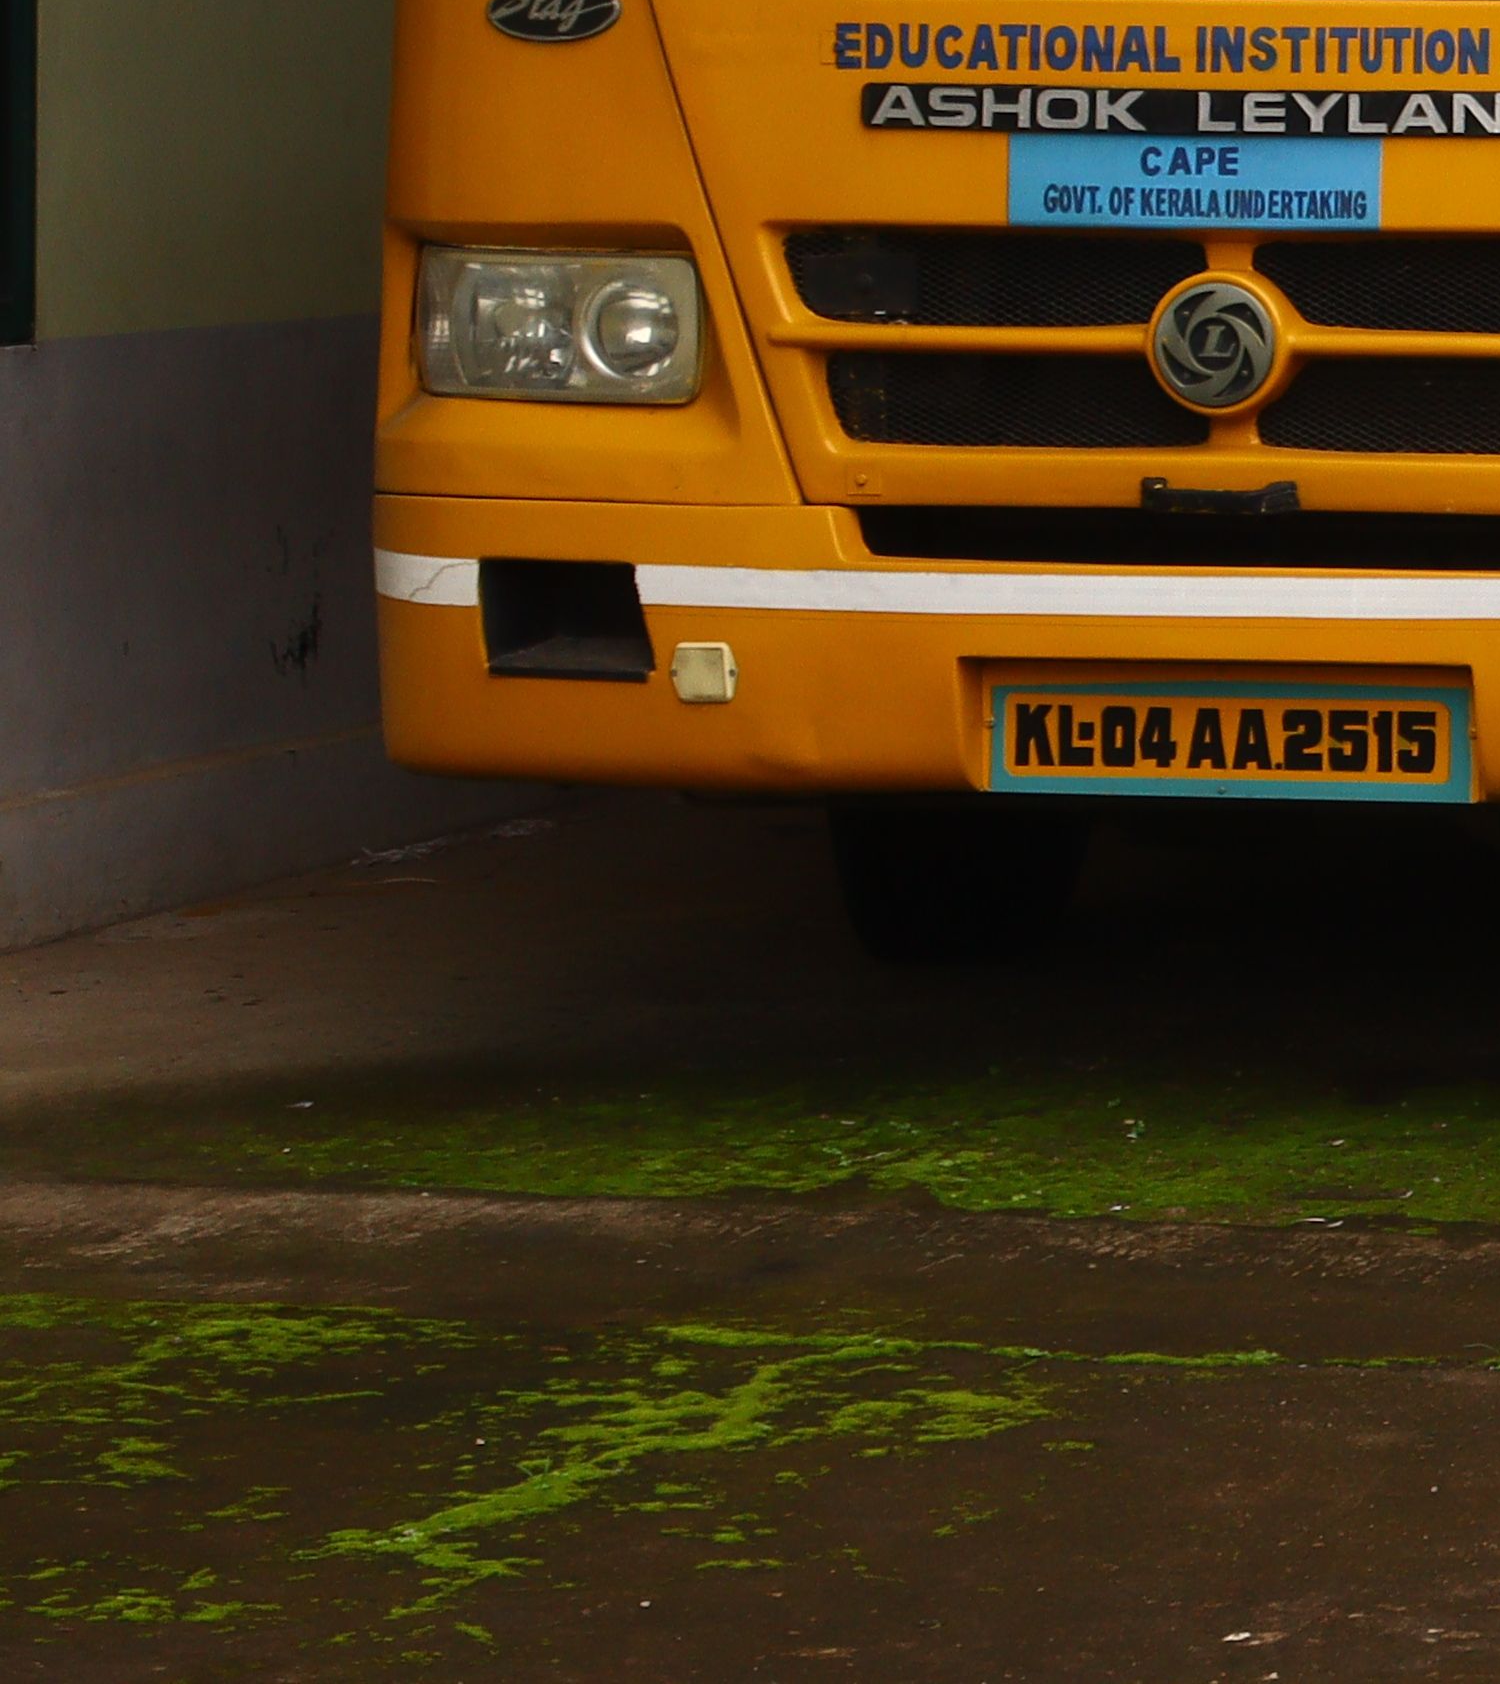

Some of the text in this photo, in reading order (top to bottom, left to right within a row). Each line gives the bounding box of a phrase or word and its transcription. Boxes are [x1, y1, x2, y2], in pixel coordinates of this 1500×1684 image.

[834, 22, 1181, 74] EDUCATIONAL
[1196, 26, 1488, 75] INSTITUTION
[871, 85, 1146, 131] ASHOK
[1140, 147, 1239, 177] CAPE
[1043, 186, 1366, 221] GOVT. OF KERALA UNDERTAKING
